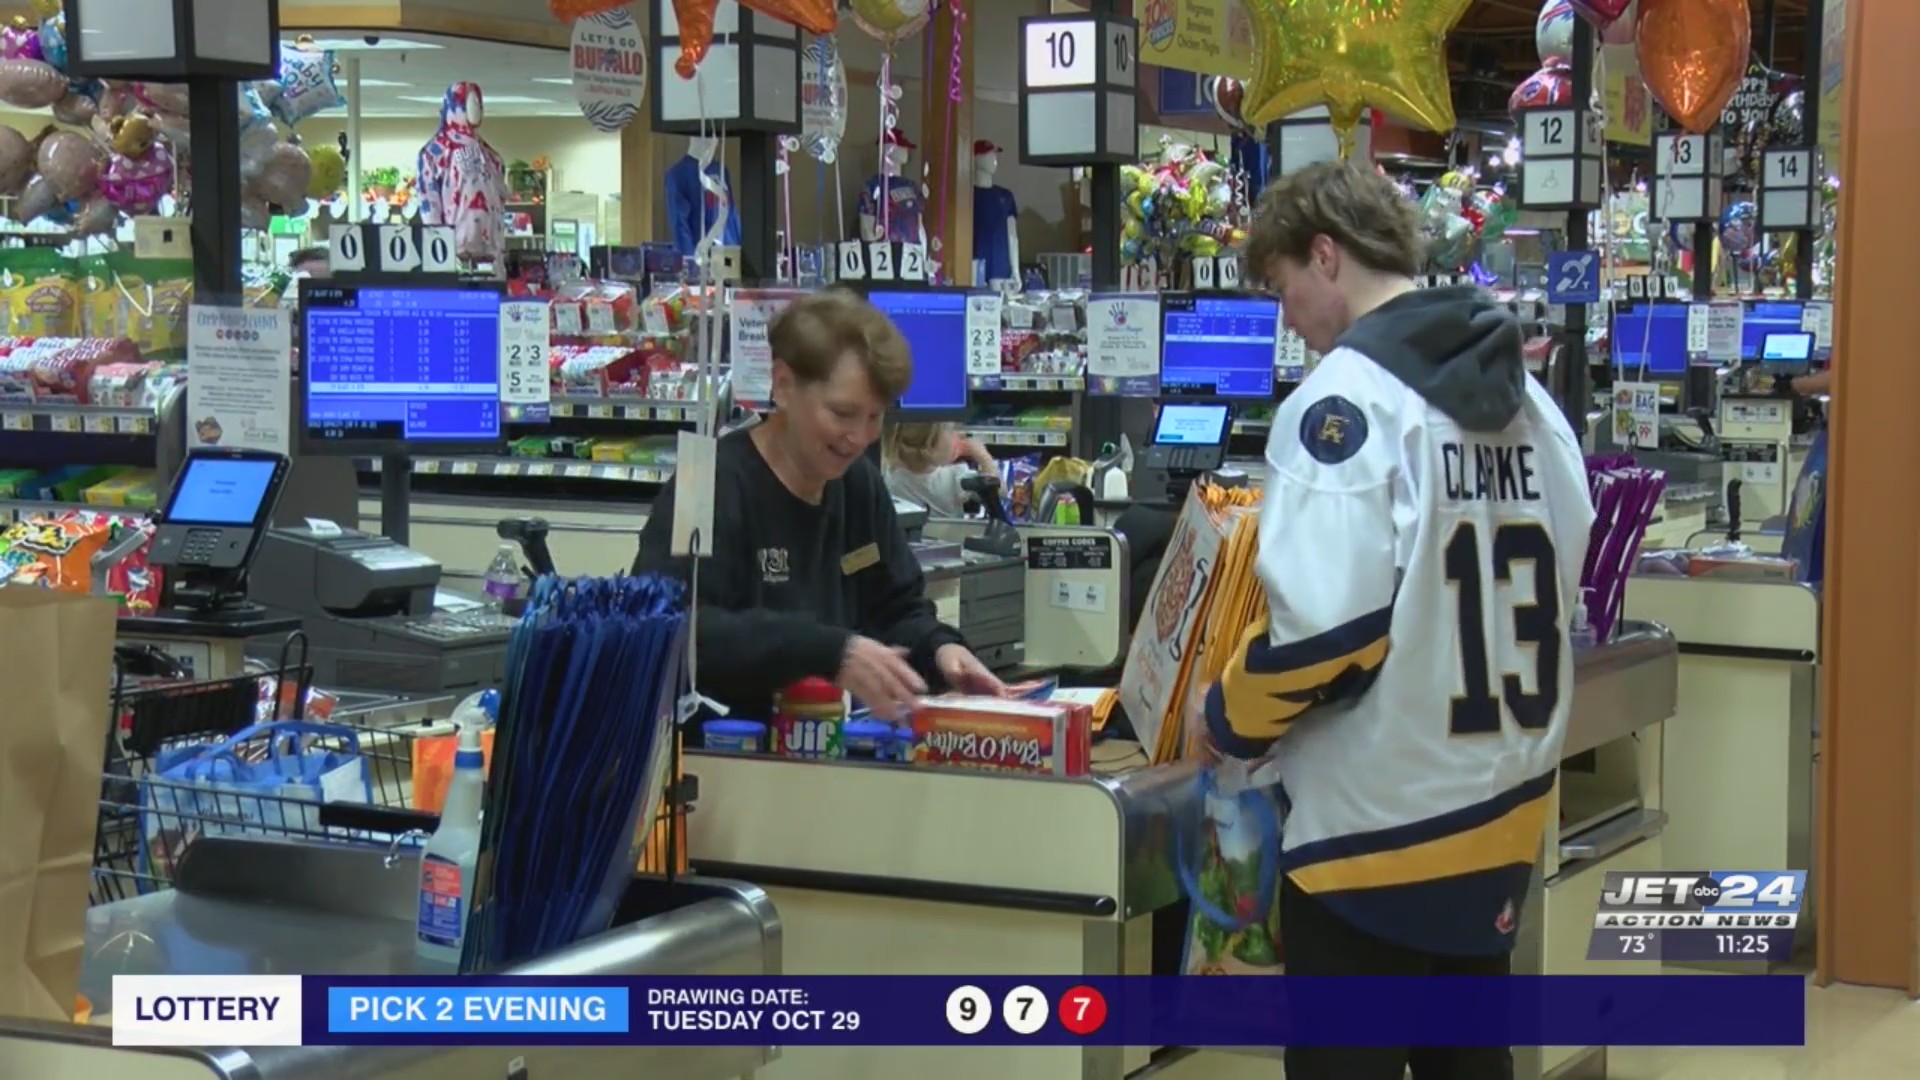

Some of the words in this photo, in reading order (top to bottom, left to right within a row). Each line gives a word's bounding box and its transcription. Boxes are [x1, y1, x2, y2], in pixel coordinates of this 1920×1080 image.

[581, 32, 615, 46] LET'S
[619, 37, 636, 48] GO
[1046, 31, 1075, 68] 10
[1114, 33, 1127, 72] 10
[1540, 118, 1562, 144] 12
[1671, 139, 1692, 164] 13
[1778, 155, 1797, 178] 14
[1444, 519, 1562, 735] 13
[785, 720, 836, 751] Jif
